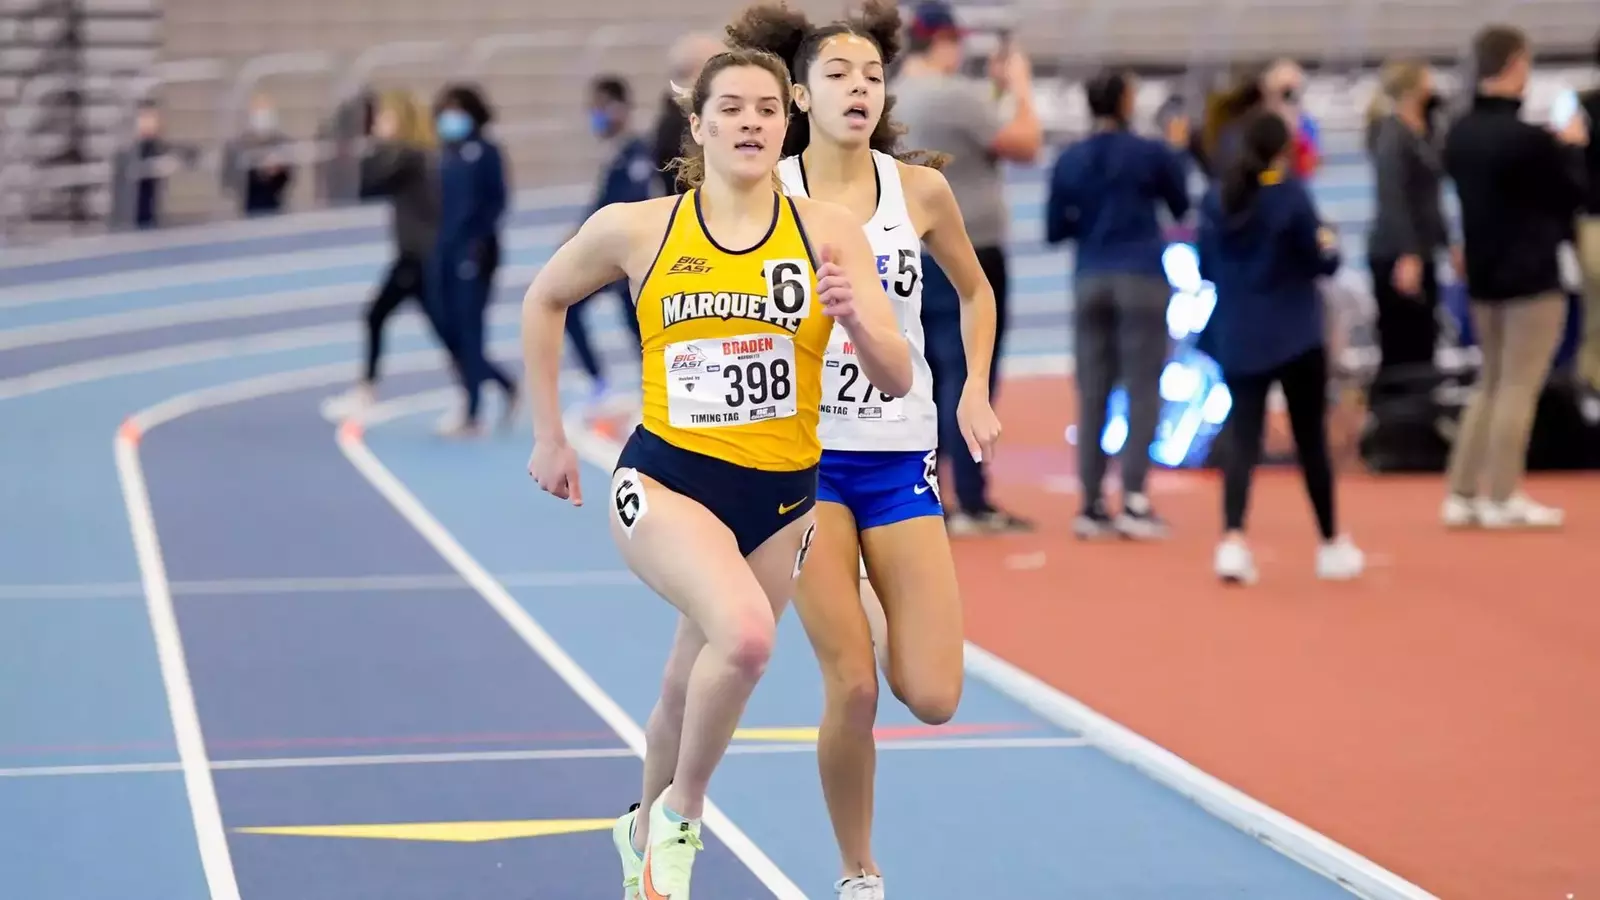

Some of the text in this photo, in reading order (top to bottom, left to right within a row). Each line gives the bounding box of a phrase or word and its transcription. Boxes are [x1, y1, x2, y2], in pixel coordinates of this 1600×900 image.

[676, 255, 708, 265] BIG
[670, 264, 714, 273] EAST
[894, 249, 918, 298] 5
[772, 262, 805, 314] 6
[661, 291, 802, 335] MARQUE
[722, 338, 773, 355] BRADEN
[671, 360, 705, 369] EAST
[674, 353, 697, 362] BIG
[723, 358, 791, 408] 398
[691, 412, 721, 423] TIMING
[723, 412, 739, 422] TAG
[833, 405, 848, 416] TAG
[616, 480, 640, 528] 6
